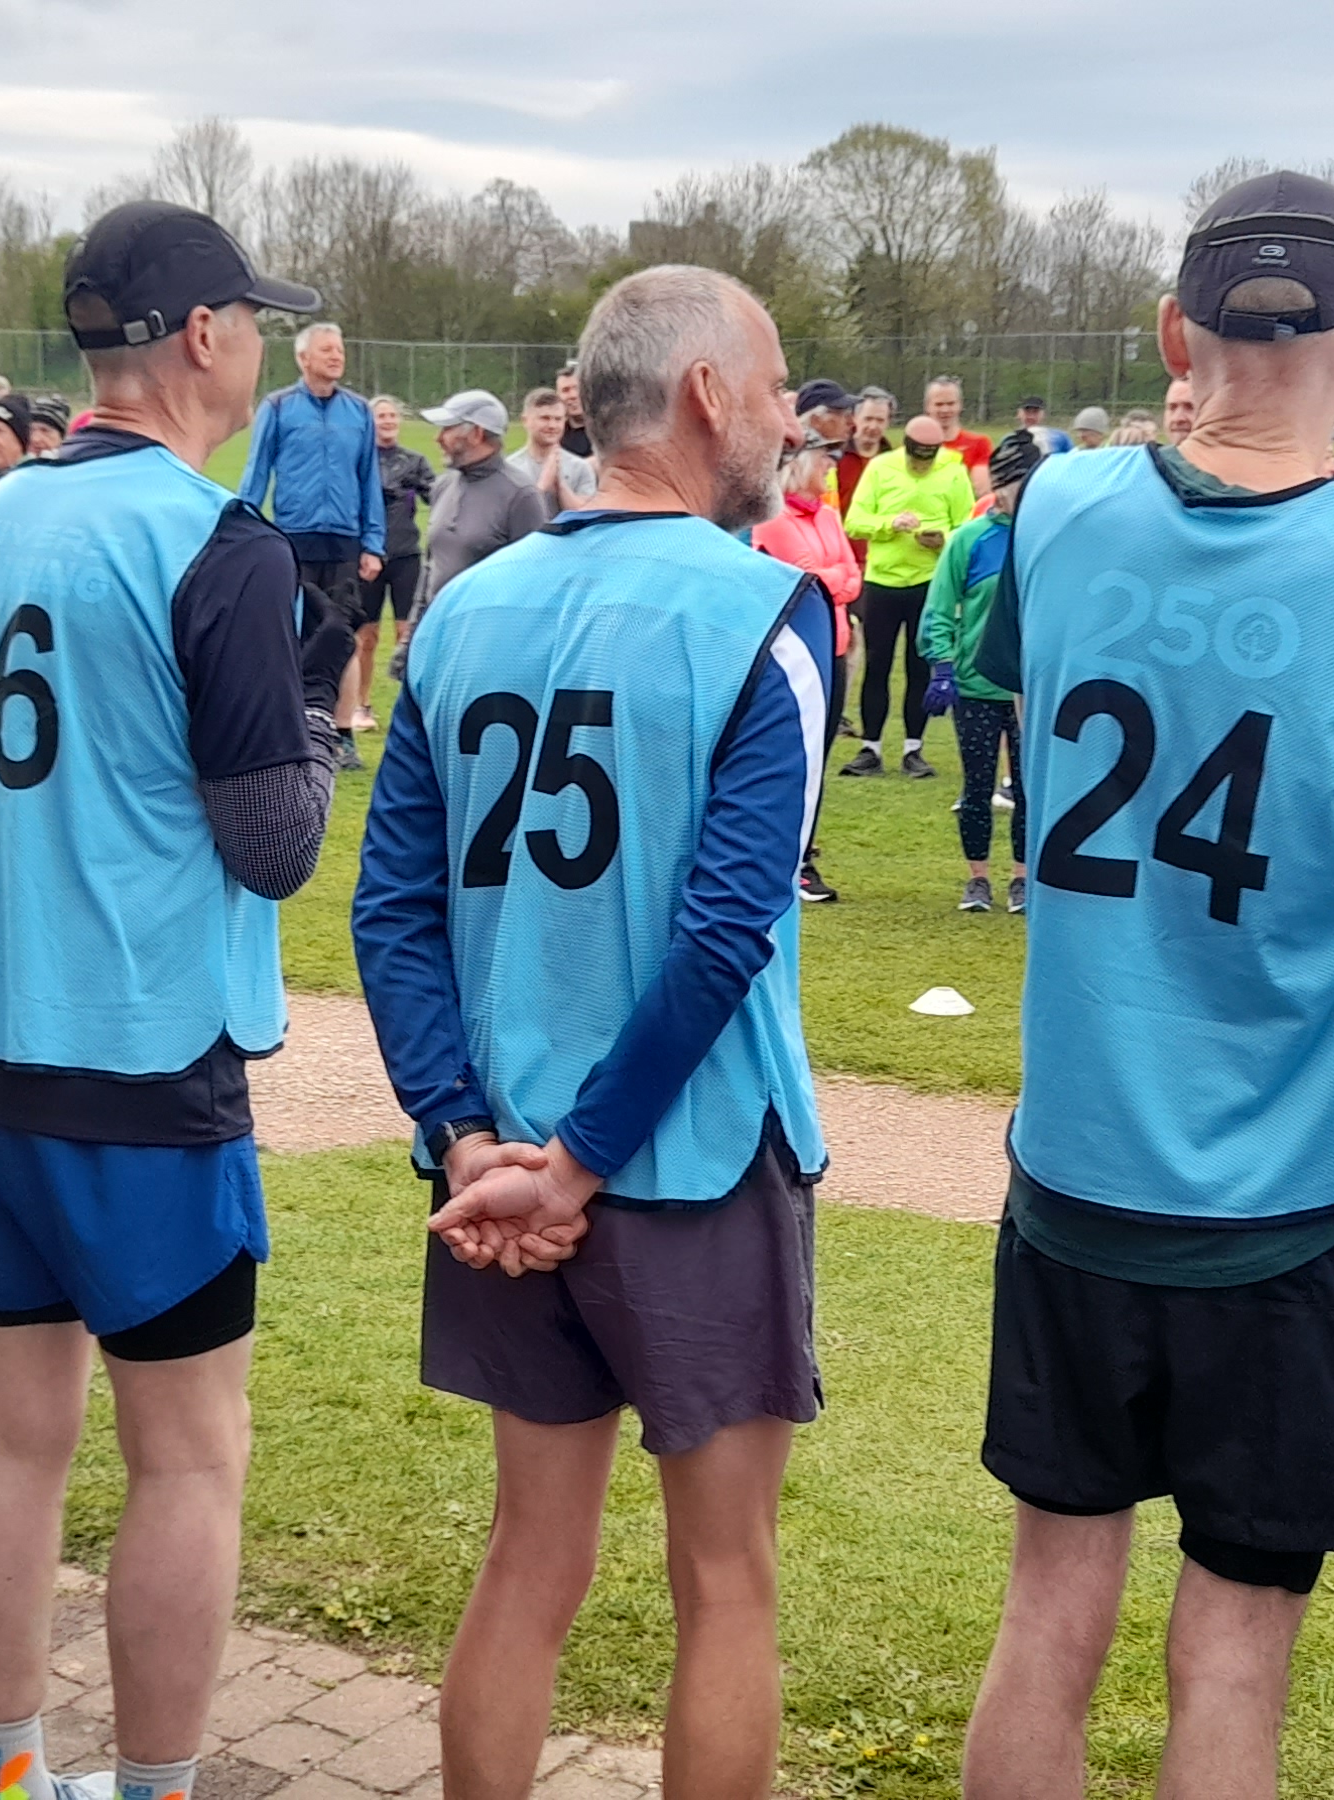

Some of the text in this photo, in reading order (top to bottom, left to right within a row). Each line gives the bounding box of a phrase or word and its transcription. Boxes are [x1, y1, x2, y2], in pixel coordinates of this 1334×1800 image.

[1069, 570, 1302, 679] 250
[458, 688, 620, 890] 25
[1037, 678, 1274, 926] 24
